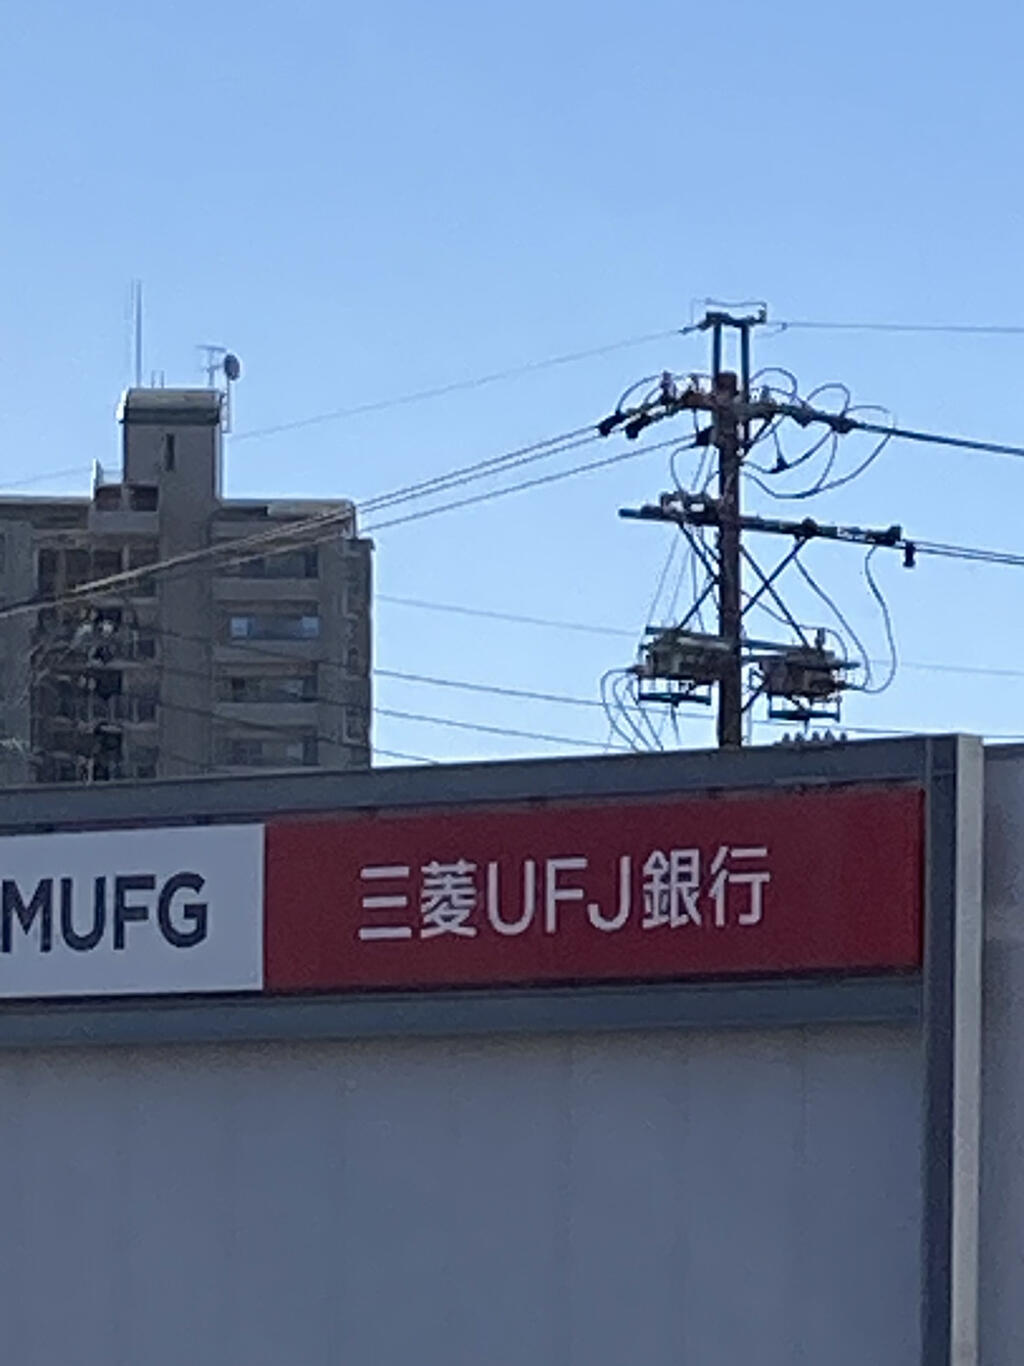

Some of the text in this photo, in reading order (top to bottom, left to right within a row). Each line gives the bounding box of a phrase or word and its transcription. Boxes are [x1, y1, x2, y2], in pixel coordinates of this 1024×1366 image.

[1, 872, 208, 953] MUFG
[358, 845, 771, 941] 三菱UFJ銀行
